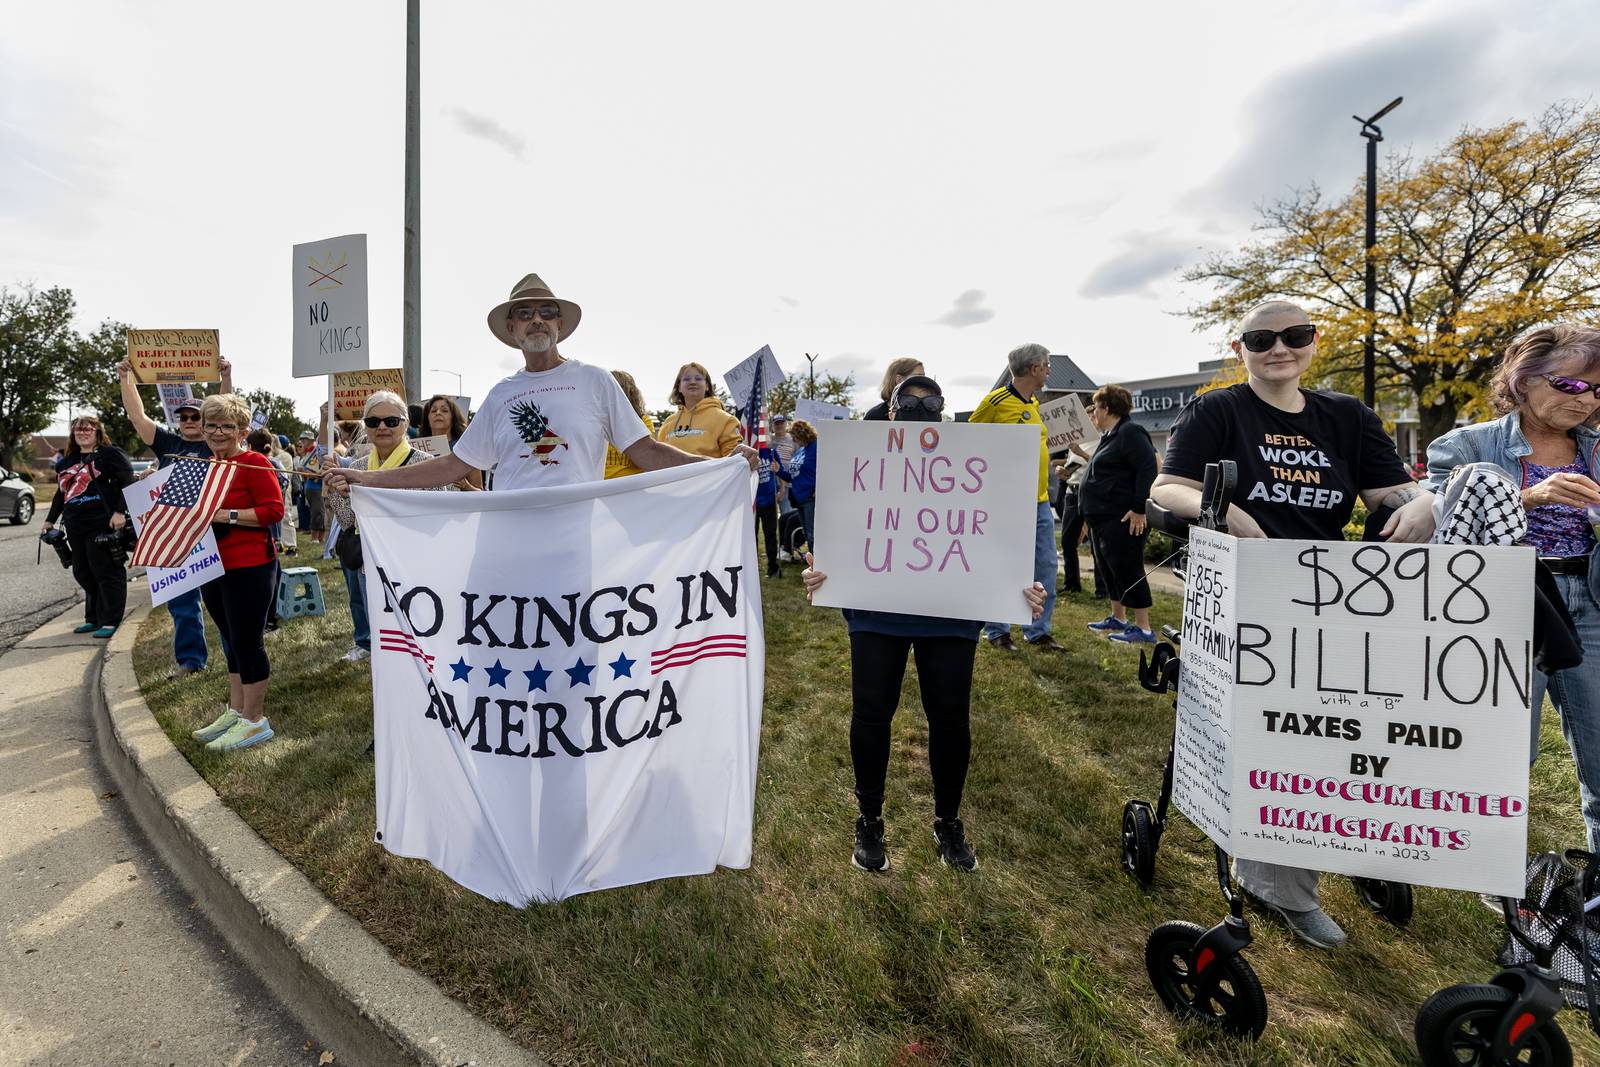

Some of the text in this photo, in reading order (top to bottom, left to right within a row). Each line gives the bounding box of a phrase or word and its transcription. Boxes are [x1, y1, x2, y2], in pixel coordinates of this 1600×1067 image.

[310, 301, 328, 326] NO
[131, 330, 213, 347] We the People
[320, 326, 362, 356] KINGS
[348, 372, 362, 387] the
[362, 371, 398, 386] People
[1051, 405, 1066, 419] OFF
[887, 427, 940, 453] NO
[1258, 446, 1332, 467] WOKE
[853, 456, 988, 493] KINGS
[1270, 466, 1320, 484] THAN
[1247, 481, 1343, 509] ASLEEP
[866, 507, 988, 535] IN OUR
[864, 537, 971, 572] USA
[151, 553, 220, 593] USING THEM
[1188, 562, 1228, 599] 1-855-
[1291, 545, 1490, 624] $89.8
[457, 584, 658, 649] KINGS
[675, 566, 743, 630] IN
[1185, 588, 1225, 624] HELP-
[1183, 615, 1235, 664] MY-FAMILY
[1236, 622, 1530, 709] BILLION
[1320, 694, 1351, 705] with
[424, 679, 682, 758] AMERICA
[1263, 710, 1463, 750] TAXES PAID
[1350, 753, 1390, 778] BY
[1250, 768, 1528, 817] UNDOCUMENTED
[1254, 830, 1289, 844] state,
[1329, 838, 1367, 853] federal
[1375, 847, 1385, 856] in
[1259, 804, 1471, 850] IMMIGRANTS
